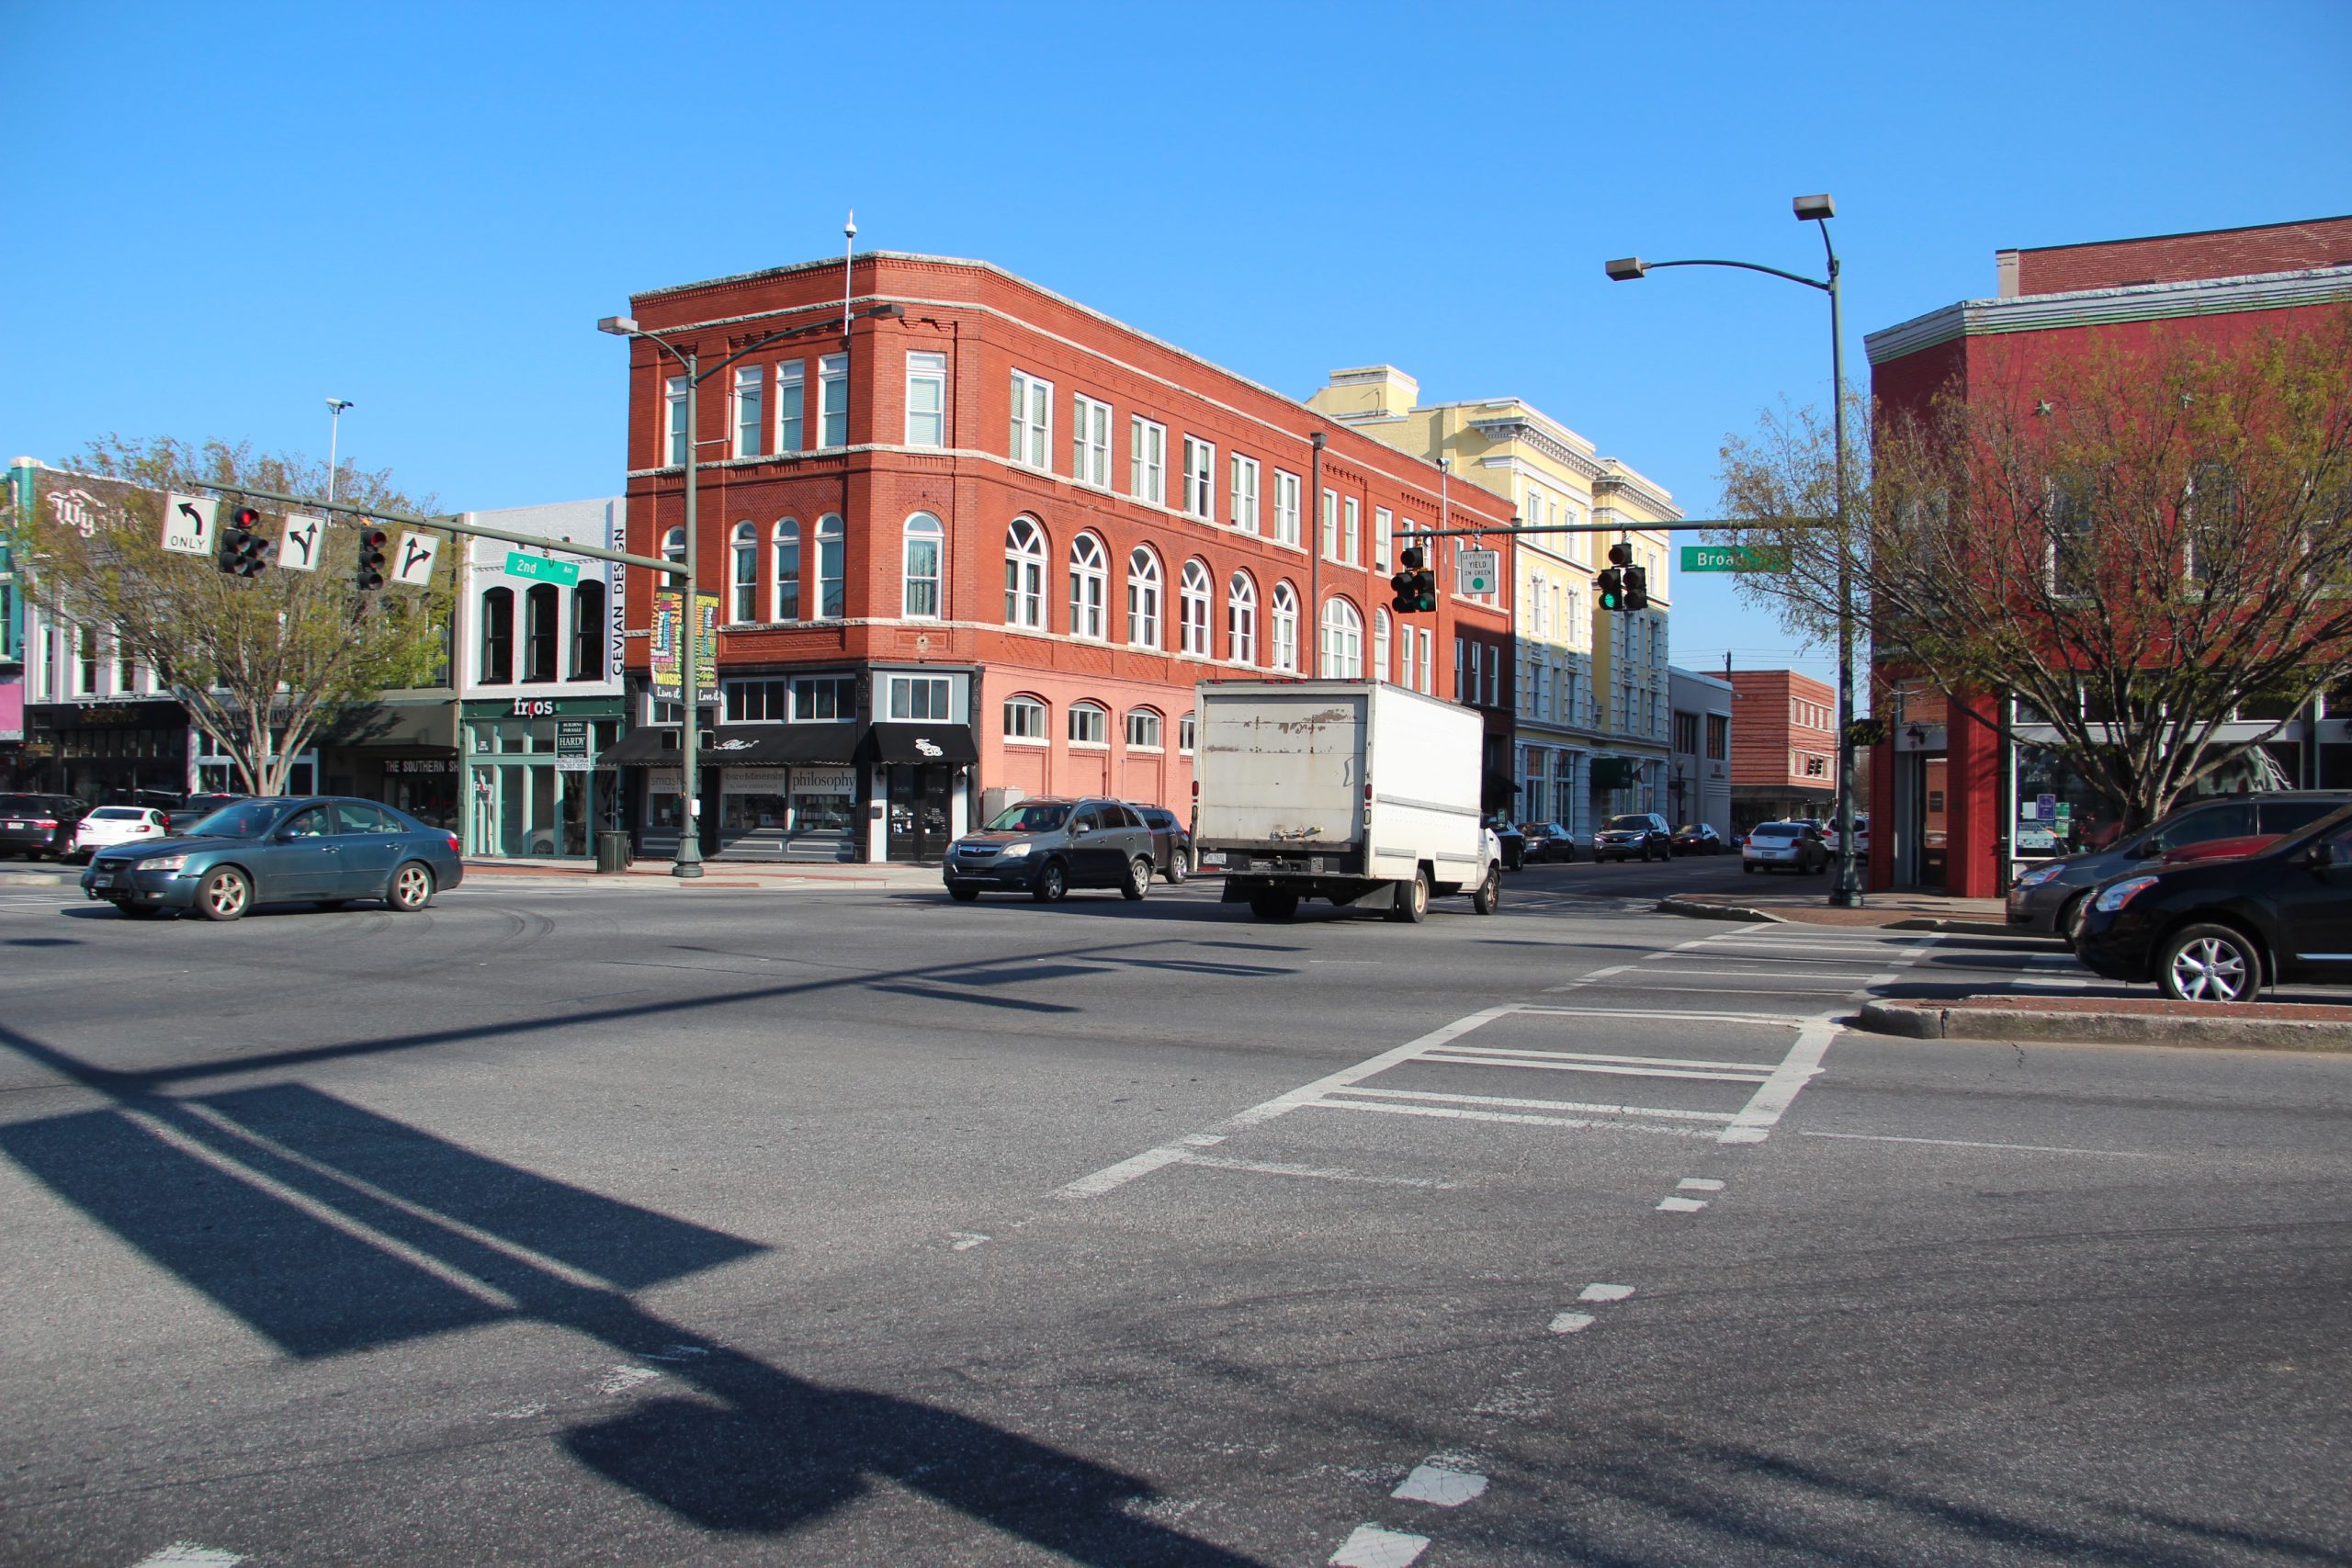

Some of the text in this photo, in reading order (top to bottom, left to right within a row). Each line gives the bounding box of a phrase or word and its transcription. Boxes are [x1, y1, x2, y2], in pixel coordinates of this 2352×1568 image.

[171, 536, 205, 549] ONLY
[516, 558, 573, 574] 2nd Ave
[1697, 552, 1744, 566] Broad
[612, 528, 625, 676] CEVIAN DESGN
[671, 592, 683, 625] ARTS
[695, 605, 704, 636] DINING
[657, 611, 665, 648] Dance
[657, 672, 682, 686] MUSIC
[657, 686, 681, 699] Live it
[698, 689, 721, 701] Love it
[559, 737, 585, 746] HARDY
[385, 761, 399, 772] THE
[402, 761, 444, 772] SOUTHERN
[792, 771, 856, 792] philosophy
